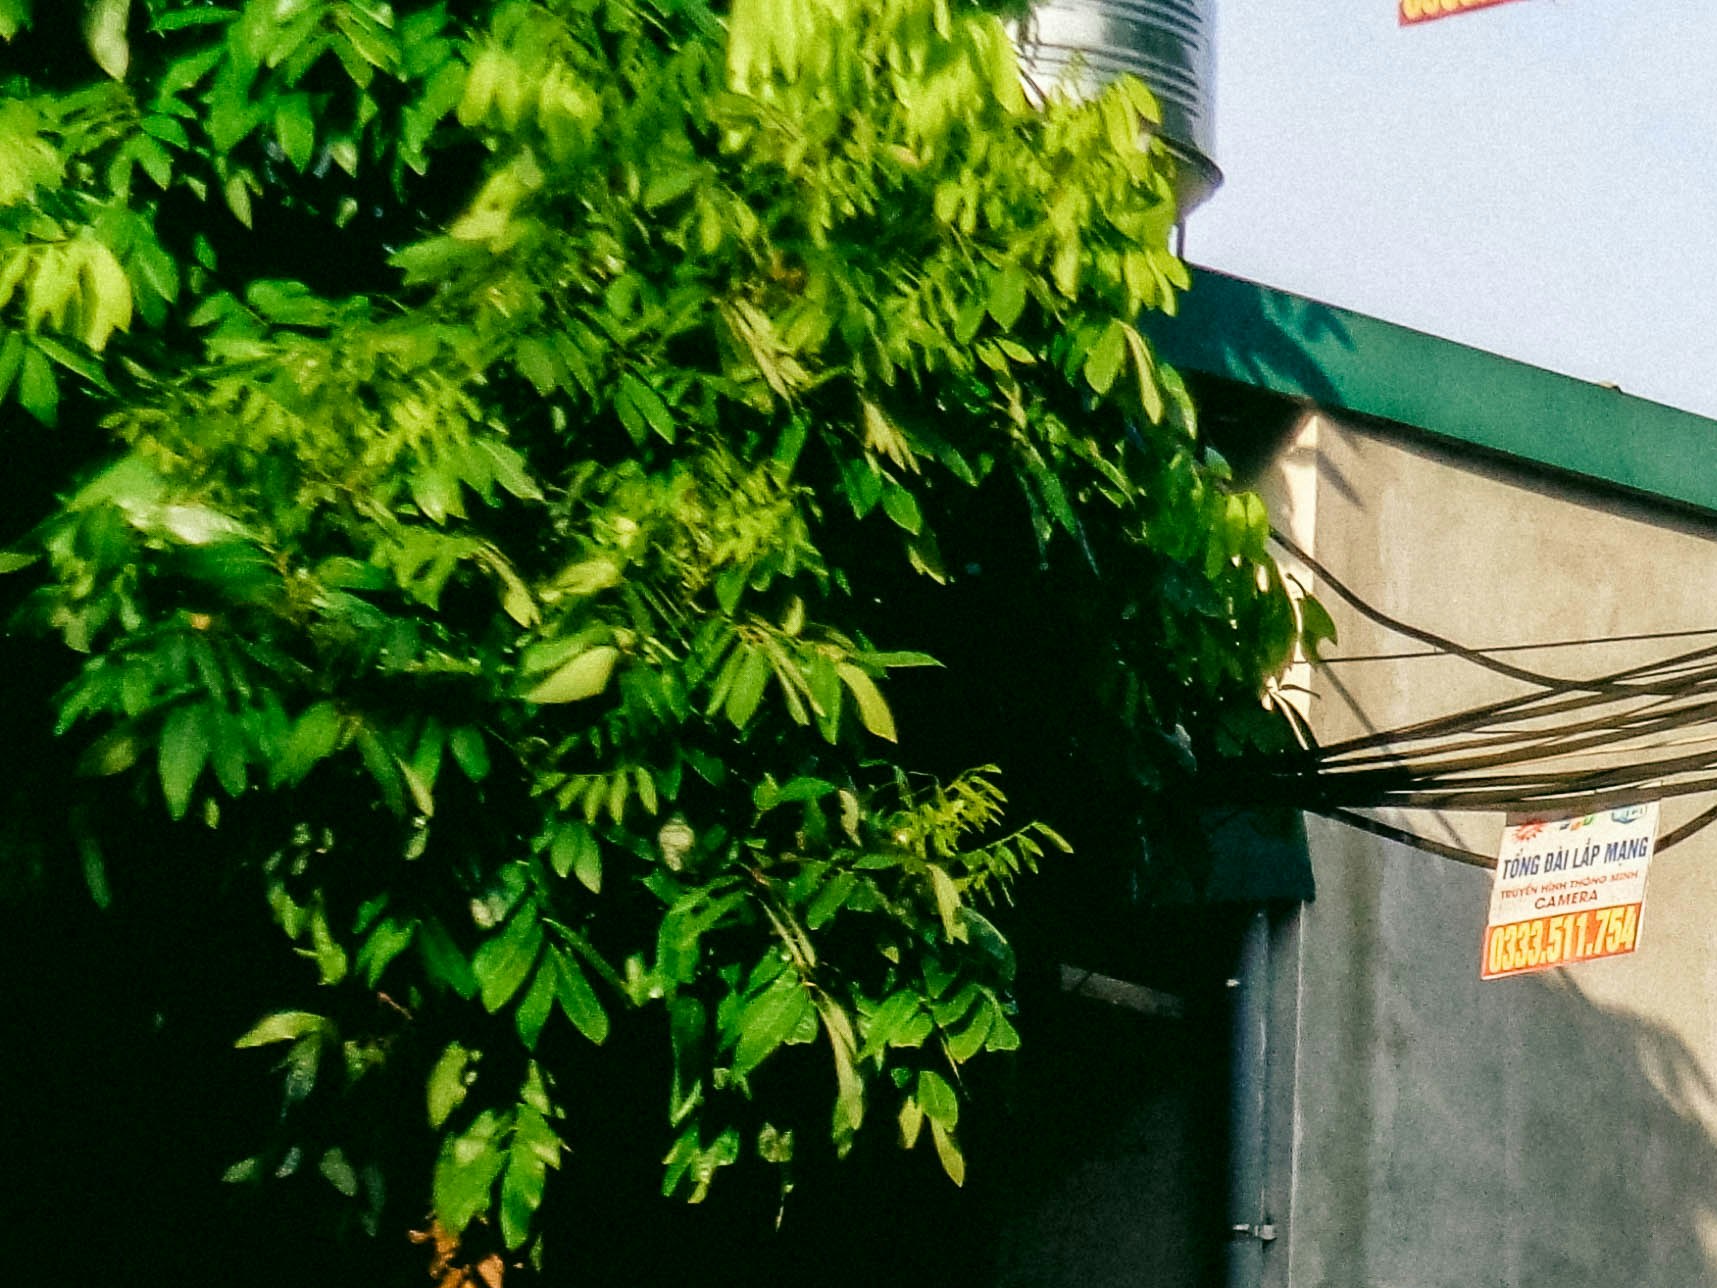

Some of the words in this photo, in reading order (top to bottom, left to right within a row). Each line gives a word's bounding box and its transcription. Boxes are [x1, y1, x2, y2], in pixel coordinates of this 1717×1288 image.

[1603, 836, 1648, 867] MẠNG
[1534, 889, 1598, 909] CAMERA
[1488, 906, 1638, 974] 0333.511.754
